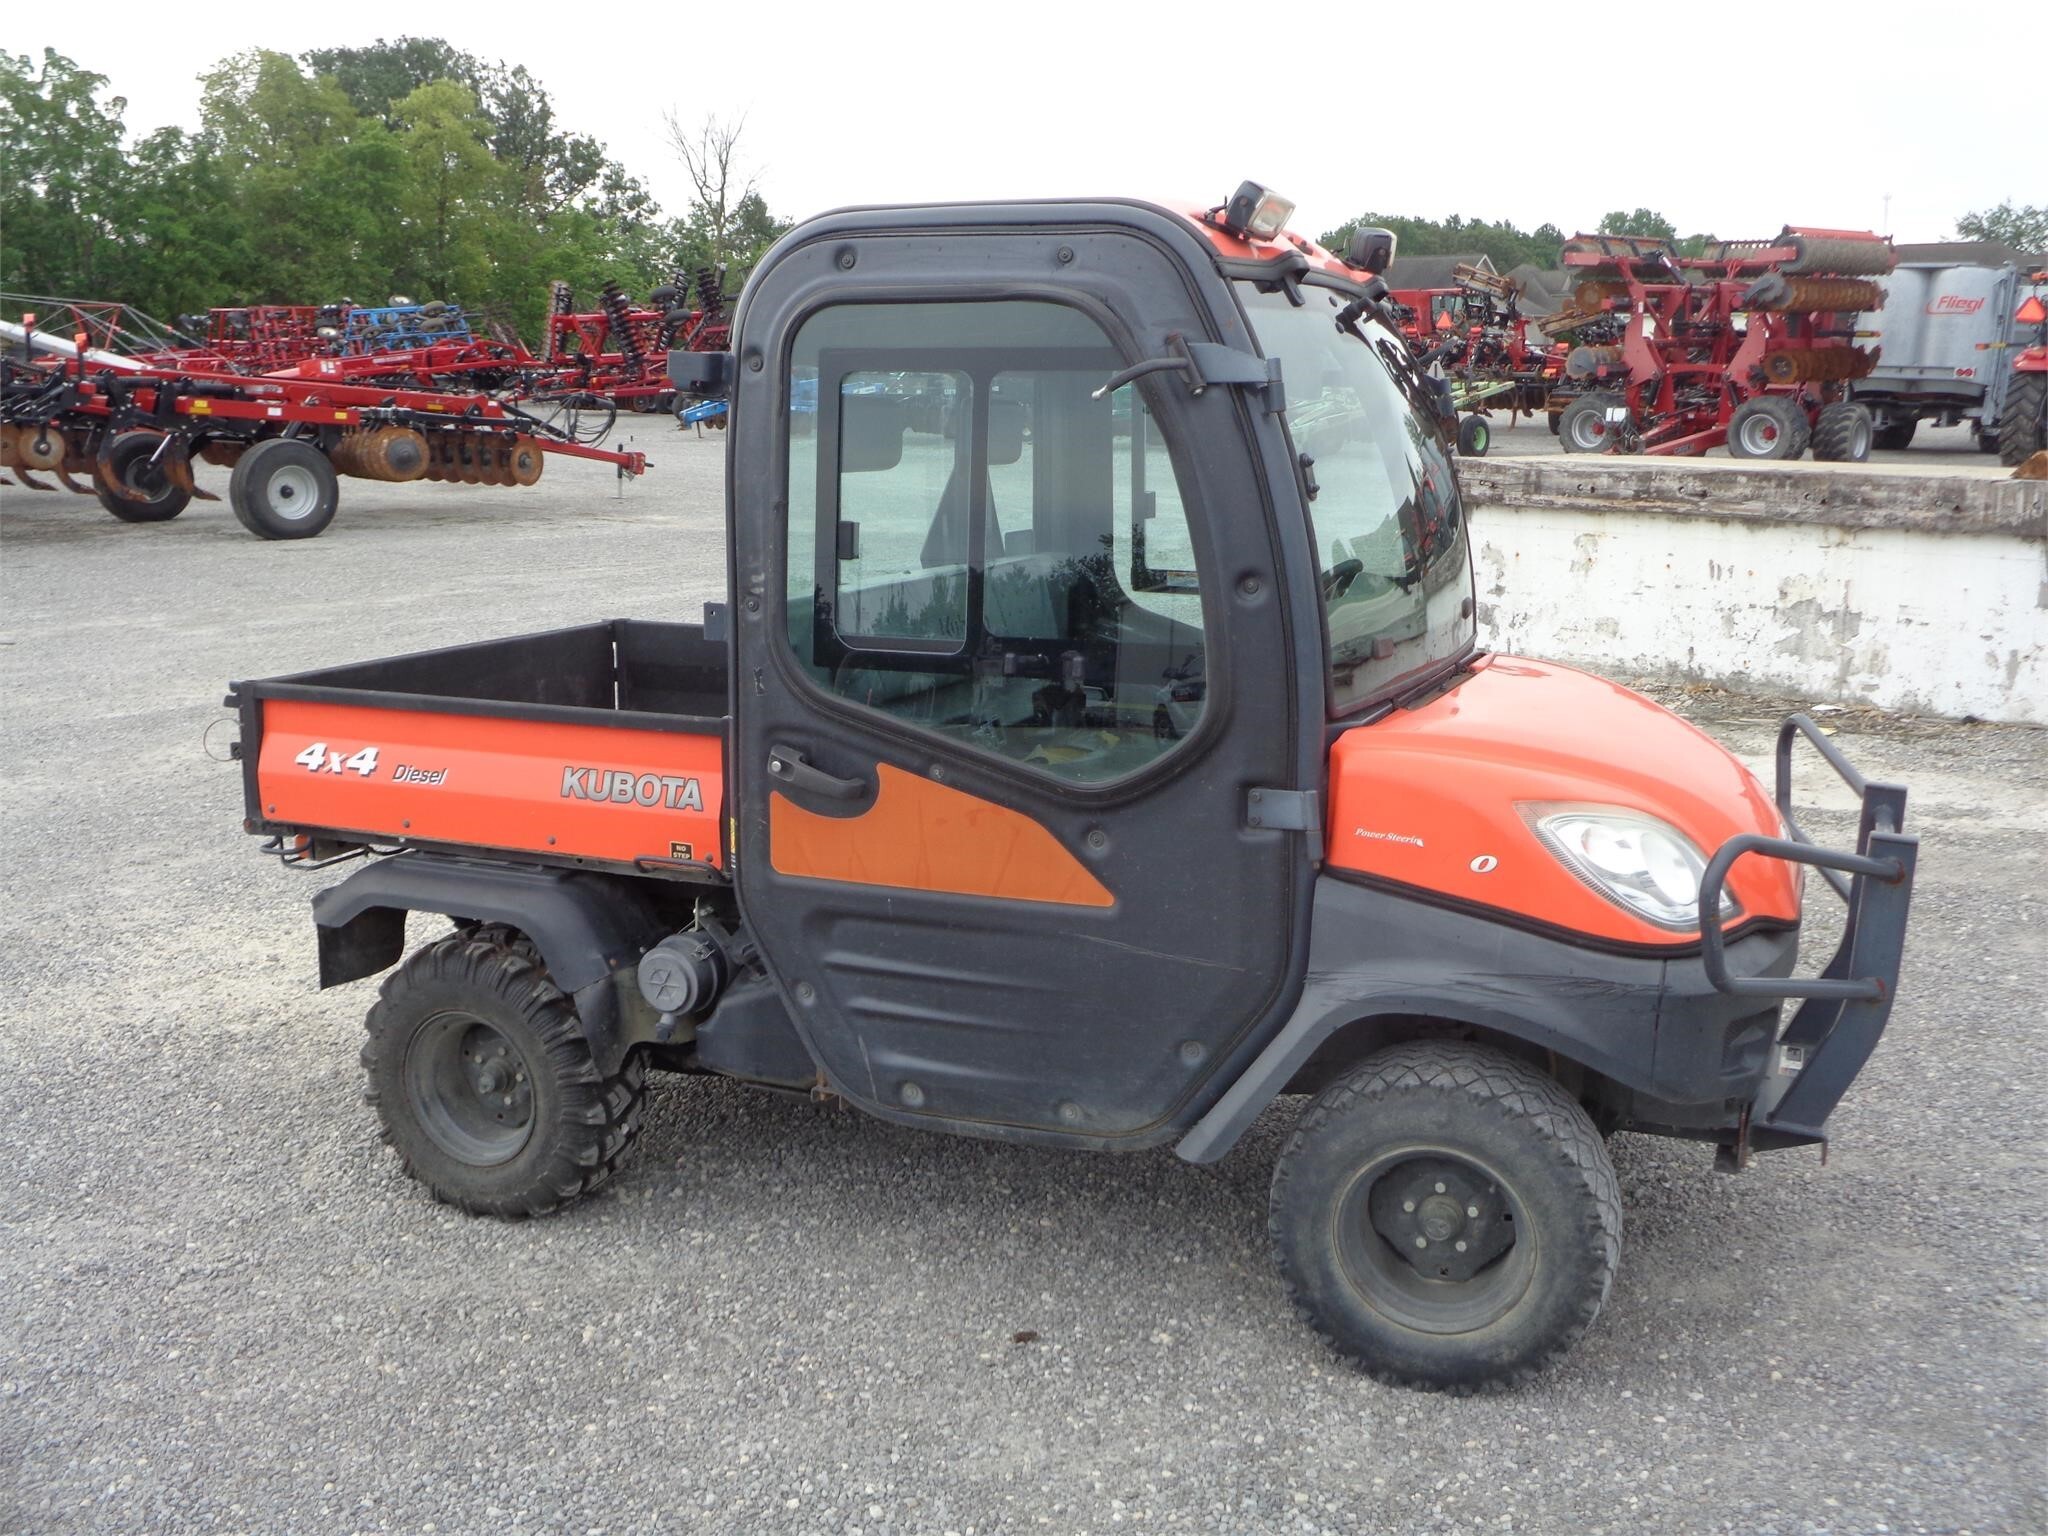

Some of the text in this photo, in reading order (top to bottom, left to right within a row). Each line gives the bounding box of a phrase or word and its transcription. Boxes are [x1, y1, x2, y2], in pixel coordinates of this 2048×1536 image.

[1937, 296, 1985, 313] Fliegl
[294, 742, 448, 785] 4x4 Diesel
[561, 766, 703, 811] KUBOTA
[1355, 828, 1385, 839] Power
[675, 844, 687, 852] NO
[672, 851, 691, 860] STEP
